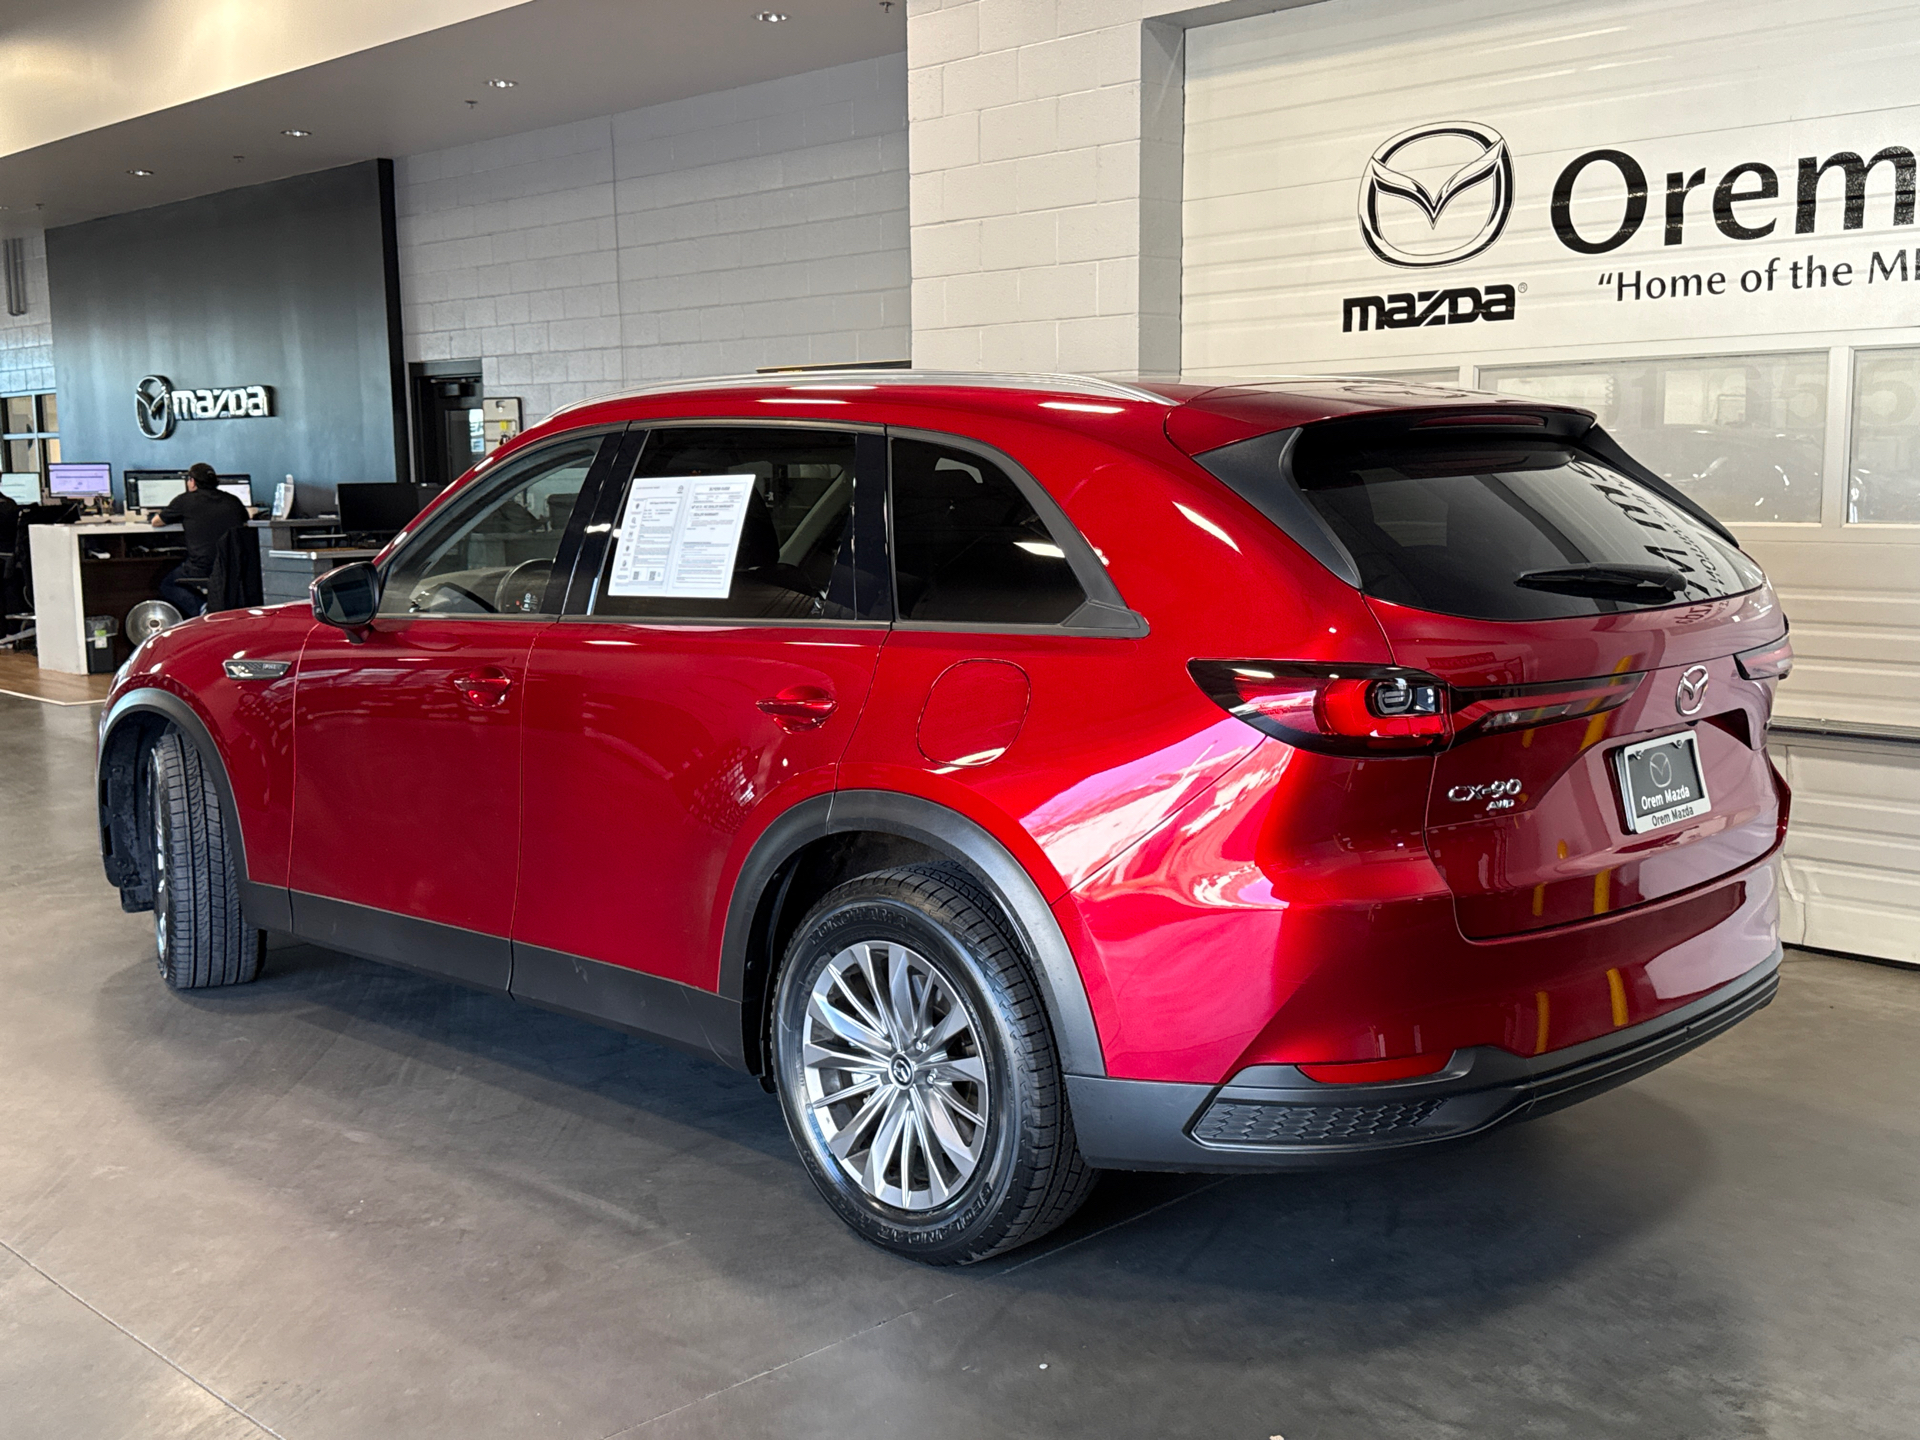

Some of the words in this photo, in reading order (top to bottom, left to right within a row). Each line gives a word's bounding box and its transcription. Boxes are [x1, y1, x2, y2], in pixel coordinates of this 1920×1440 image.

[1550, 146, 1918, 255] Orem
[1740, 257, 1781, 293] of
[1790, 255, 1853, 290] the
[1448, 778, 1523, 802] CX-90
[1641, 795, 1664, 810] Orem
[1664, 784, 1691, 804] Mazda
[1651, 814, 1671, 827] Orem
[1671, 805, 1694, 821] Mazda
[808, 906, 909, 946] YOKOHAMA
